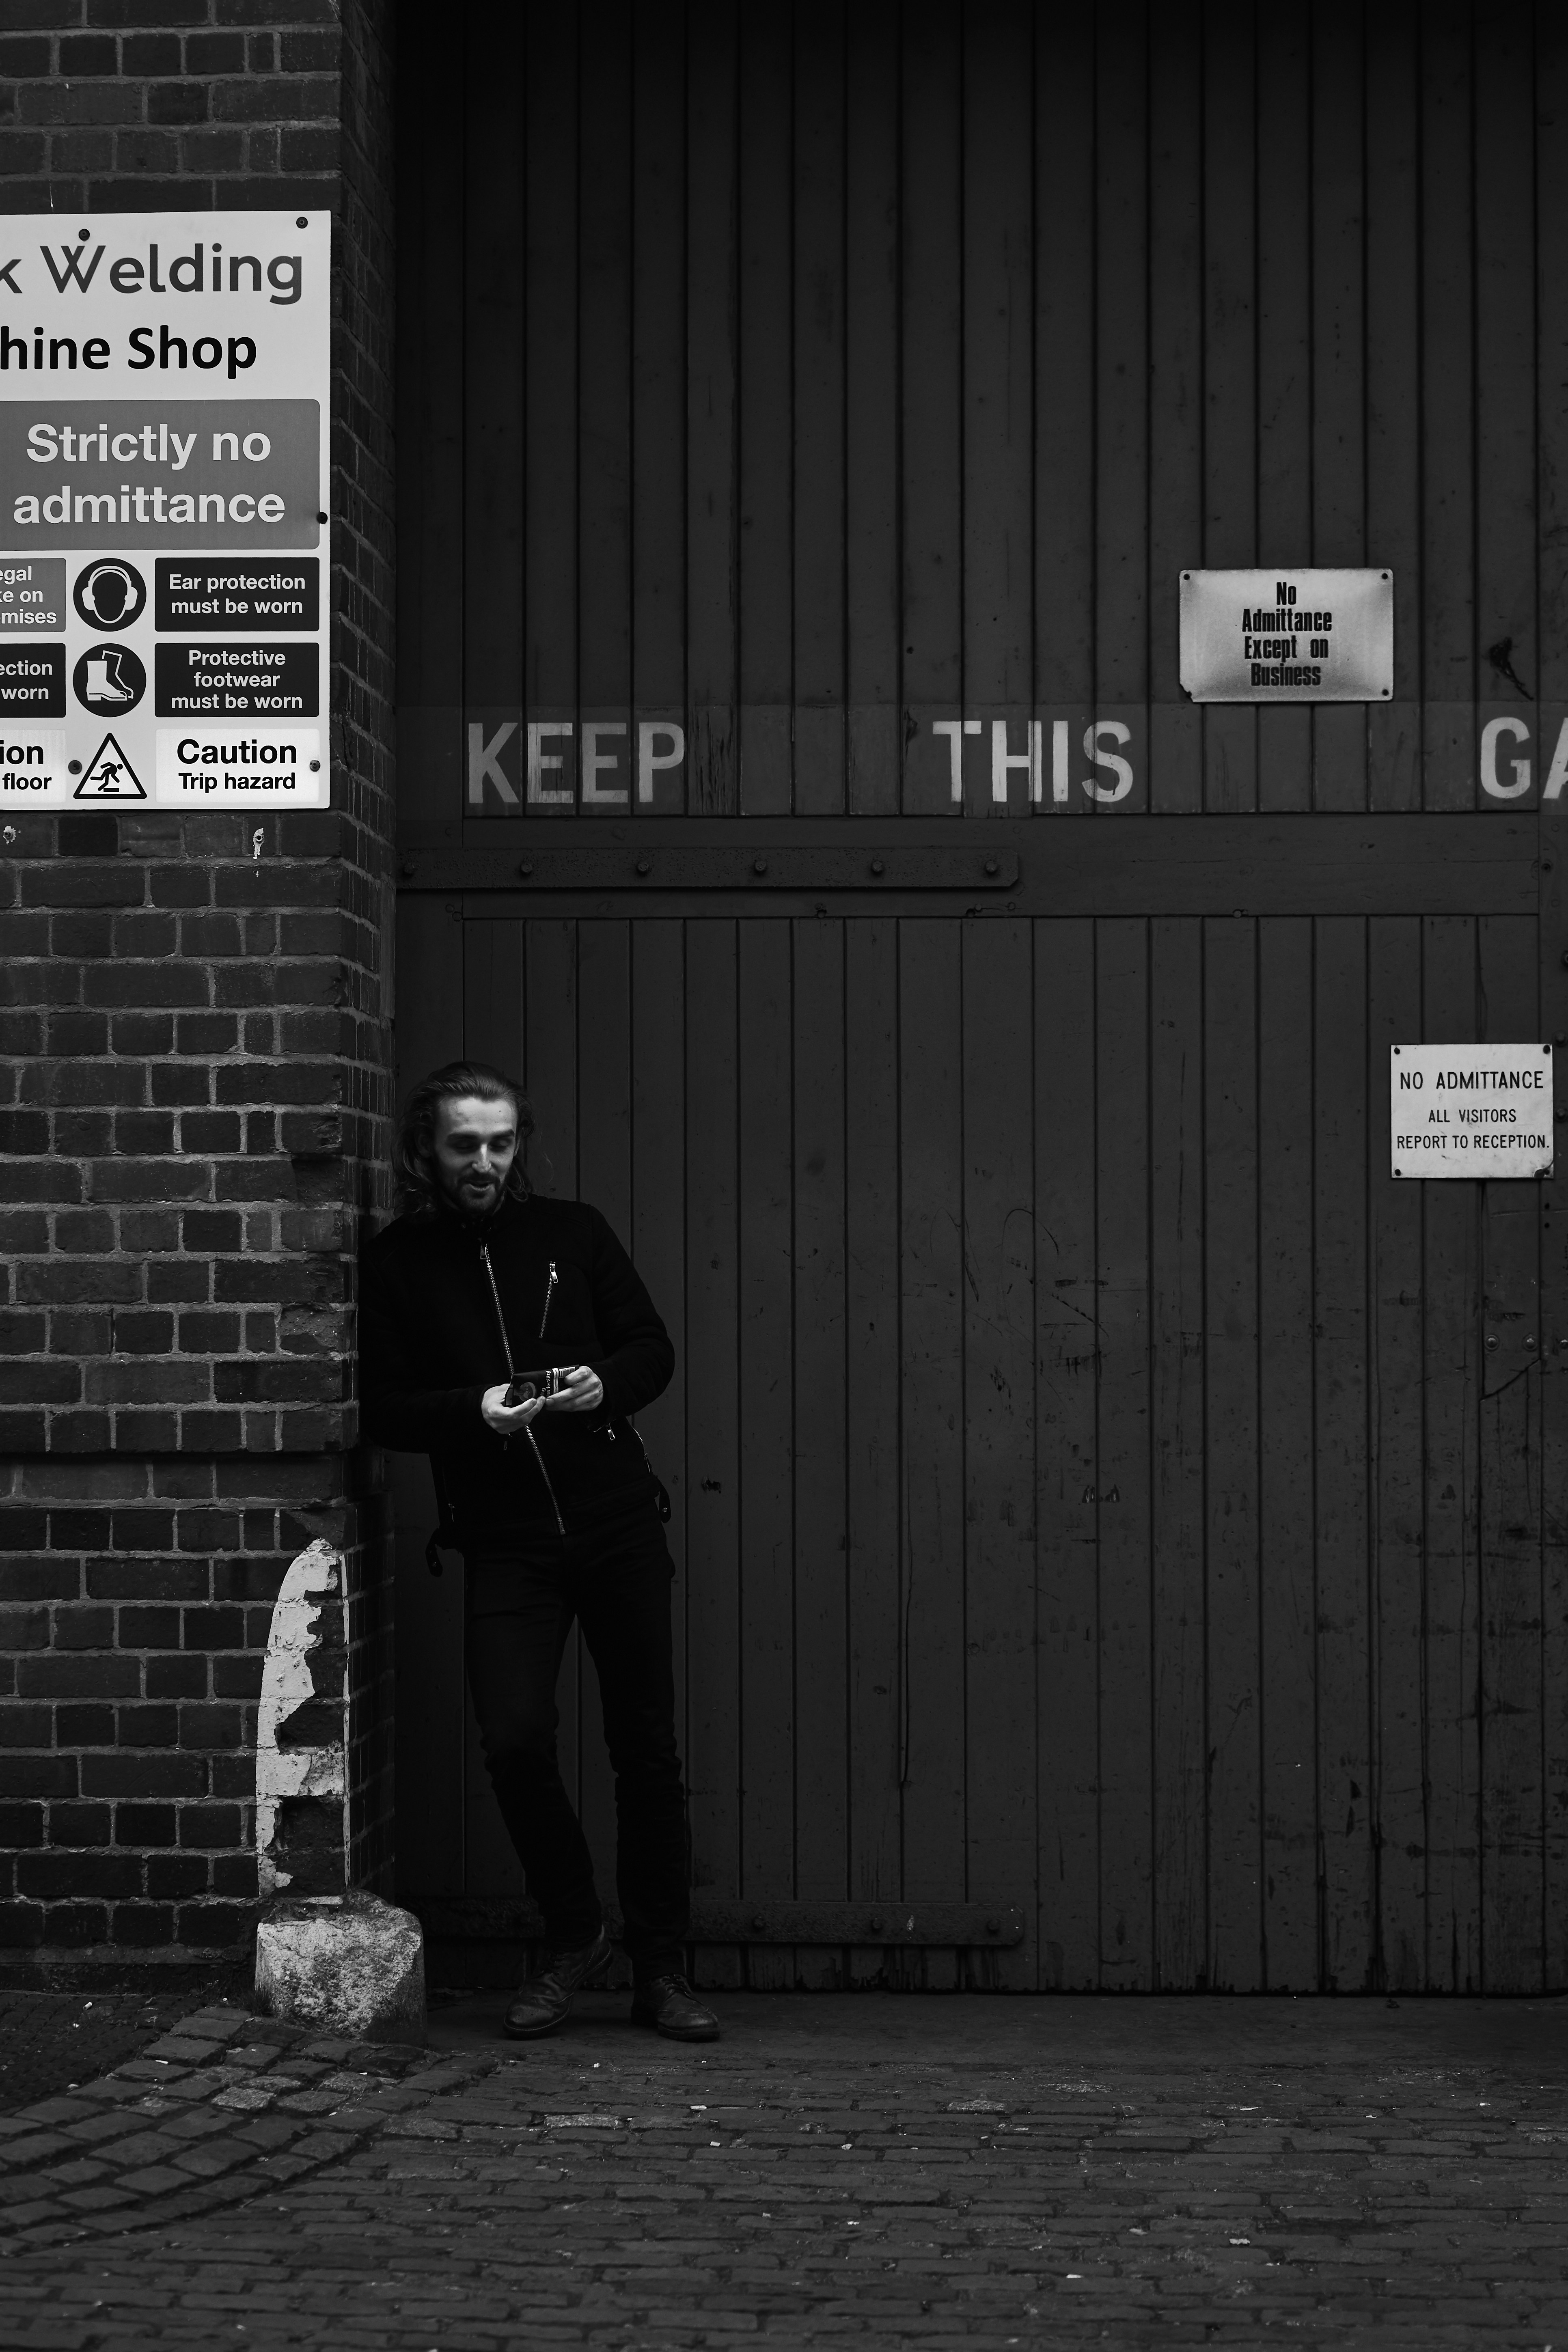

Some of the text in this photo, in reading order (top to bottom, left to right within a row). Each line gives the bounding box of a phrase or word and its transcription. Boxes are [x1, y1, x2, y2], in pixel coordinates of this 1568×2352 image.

[40, 243, 302, 305] Welding
[0, 325, 256, 379] hine Shop
[27, 424, 270, 470] Strictly no
[14, 485, 285, 524] admittance
[170, 574, 305, 593] Ear protection
[0, 591, 43, 602] e on
[1277, 582, 1296, 605] No
[172, 598, 302, 613] must be worn
[0, 609, 56, 624] mises
[1242, 608, 1332, 632] Admittance
[189, 650, 285, 665] Protective
[1244, 635, 1329, 662] Except on
[194, 672, 280, 687] footwear
[1251, 663, 1321, 686] Business
[1, 688, 48, 699] worn
[172, 694, 302, 709] must be worn
[177, 739, 296, 764] Caution
[468, 722, 684, 803] KEEP
[933, 721, 1133, 802] THIS
[2, 773, 52, 790] floor
[179, 772, 295, 793] Trip hazard
[1400, 1071, 1543, 1089] NO ADMITTANCE
[1429, 1109, 1516, 1123] ALL VISITORS
[1398, 1135, 1549, 1149] REPORT TO RECEPTION.
